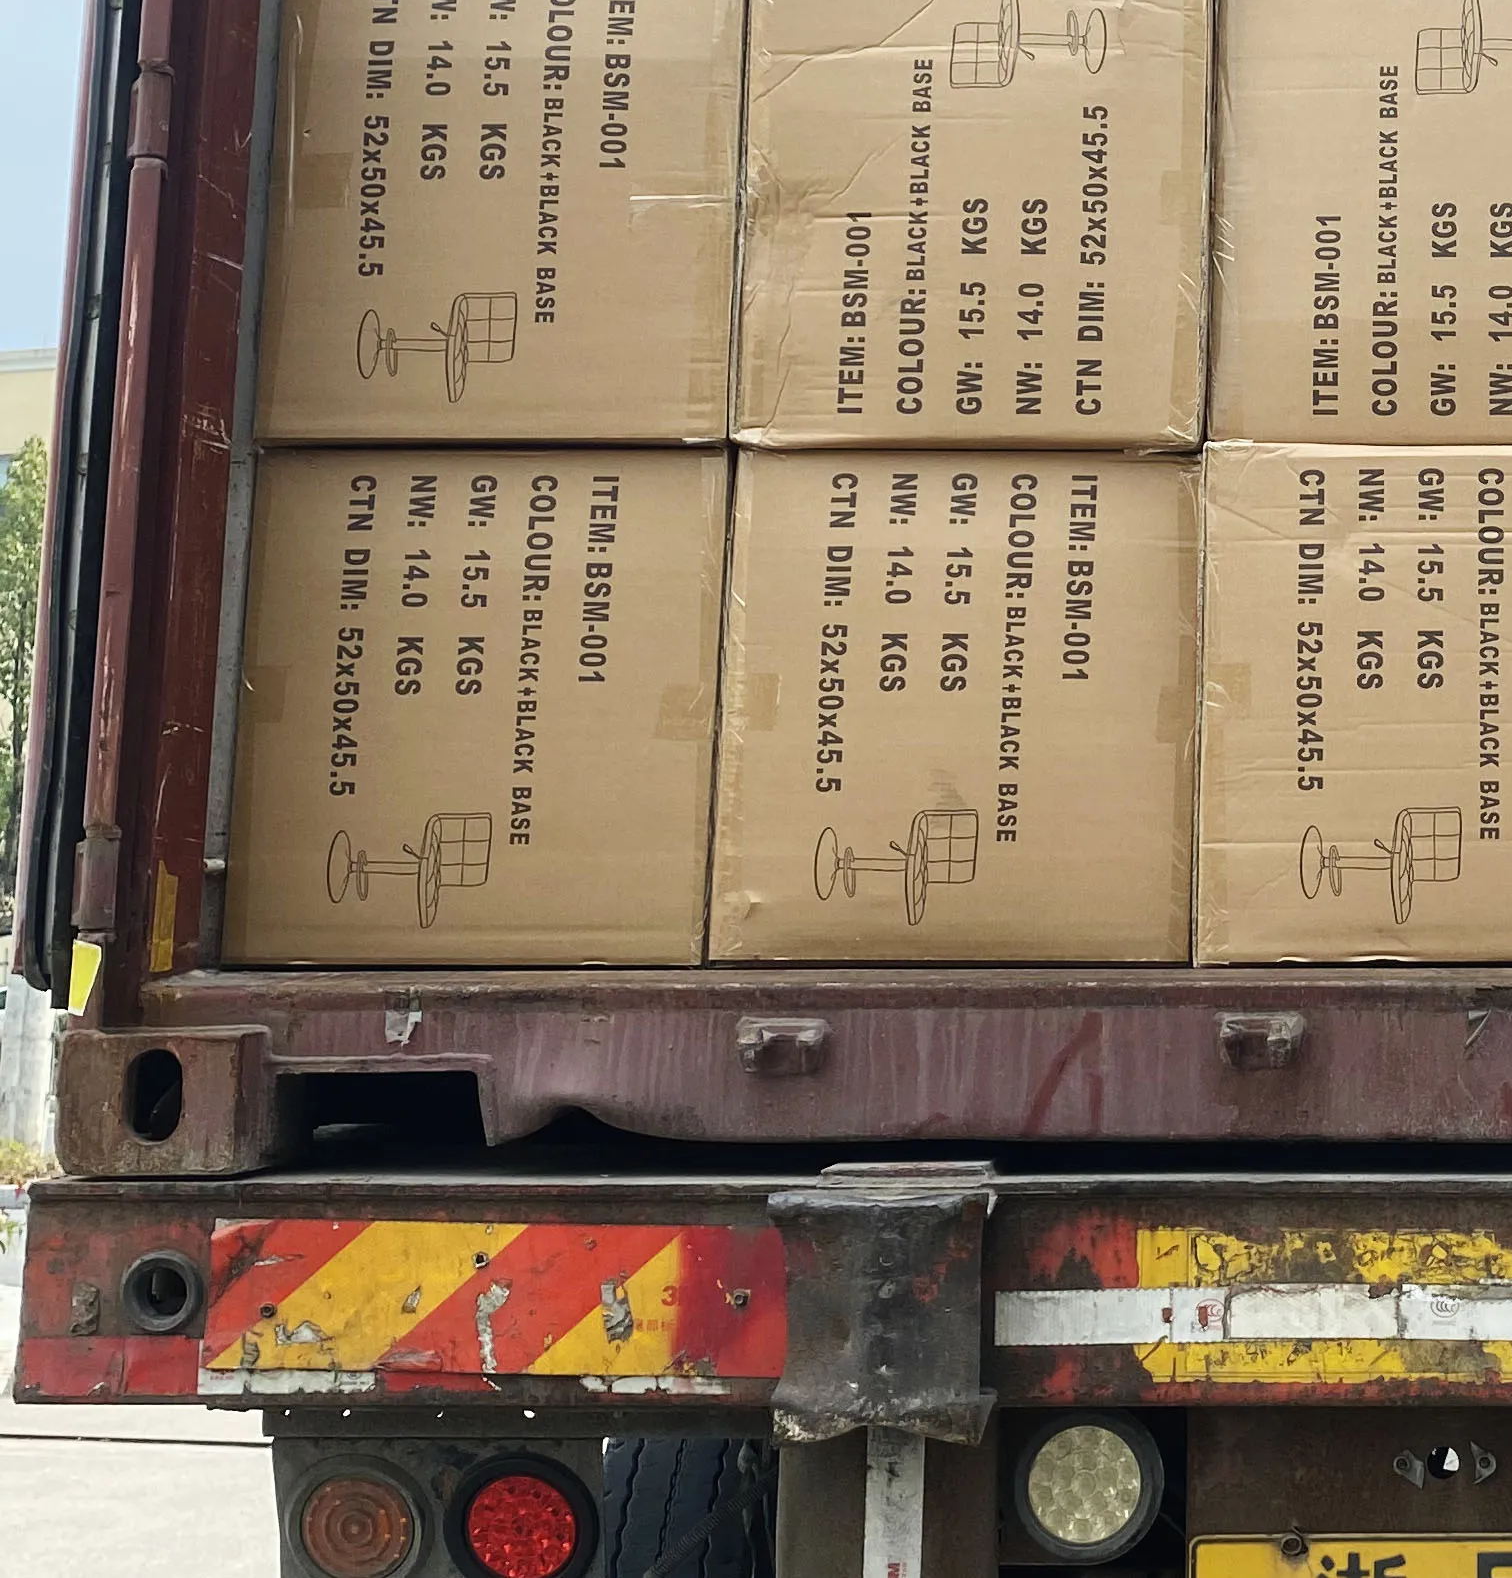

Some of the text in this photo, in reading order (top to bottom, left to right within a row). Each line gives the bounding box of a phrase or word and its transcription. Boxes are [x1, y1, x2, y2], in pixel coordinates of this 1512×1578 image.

[364, 40, 394, 99] DIM:
[478, 123, 507, 180] KGS
[482, 40, 511, 96] 15.5
[357, 115, 389, 276] 52x50x45.5
[1074, 104, 1109, 415] CTN DIM: 52x50x45.5
[1015, 198, 1048, 414] NW: 14.0 KGS
[1429, 201, 1457, 416] GW: 15.5 KGS
[328, 475, 377, 796] CTN DIM: 52x50x45.5
[393, 475, 437, 696] NW: 14.0 KGS
[814, 473, 858, 793] CTN DIM: 52x50x45.5
[939, 473, 977, 692] GW: 15.5 KGS
[1295, 469, 1325, 791] CTN DIM: 52x50x45.5
[1355, 468, 1385, 689] NW: 14.0 KGS
[508, 786, 532, 845] BASE
